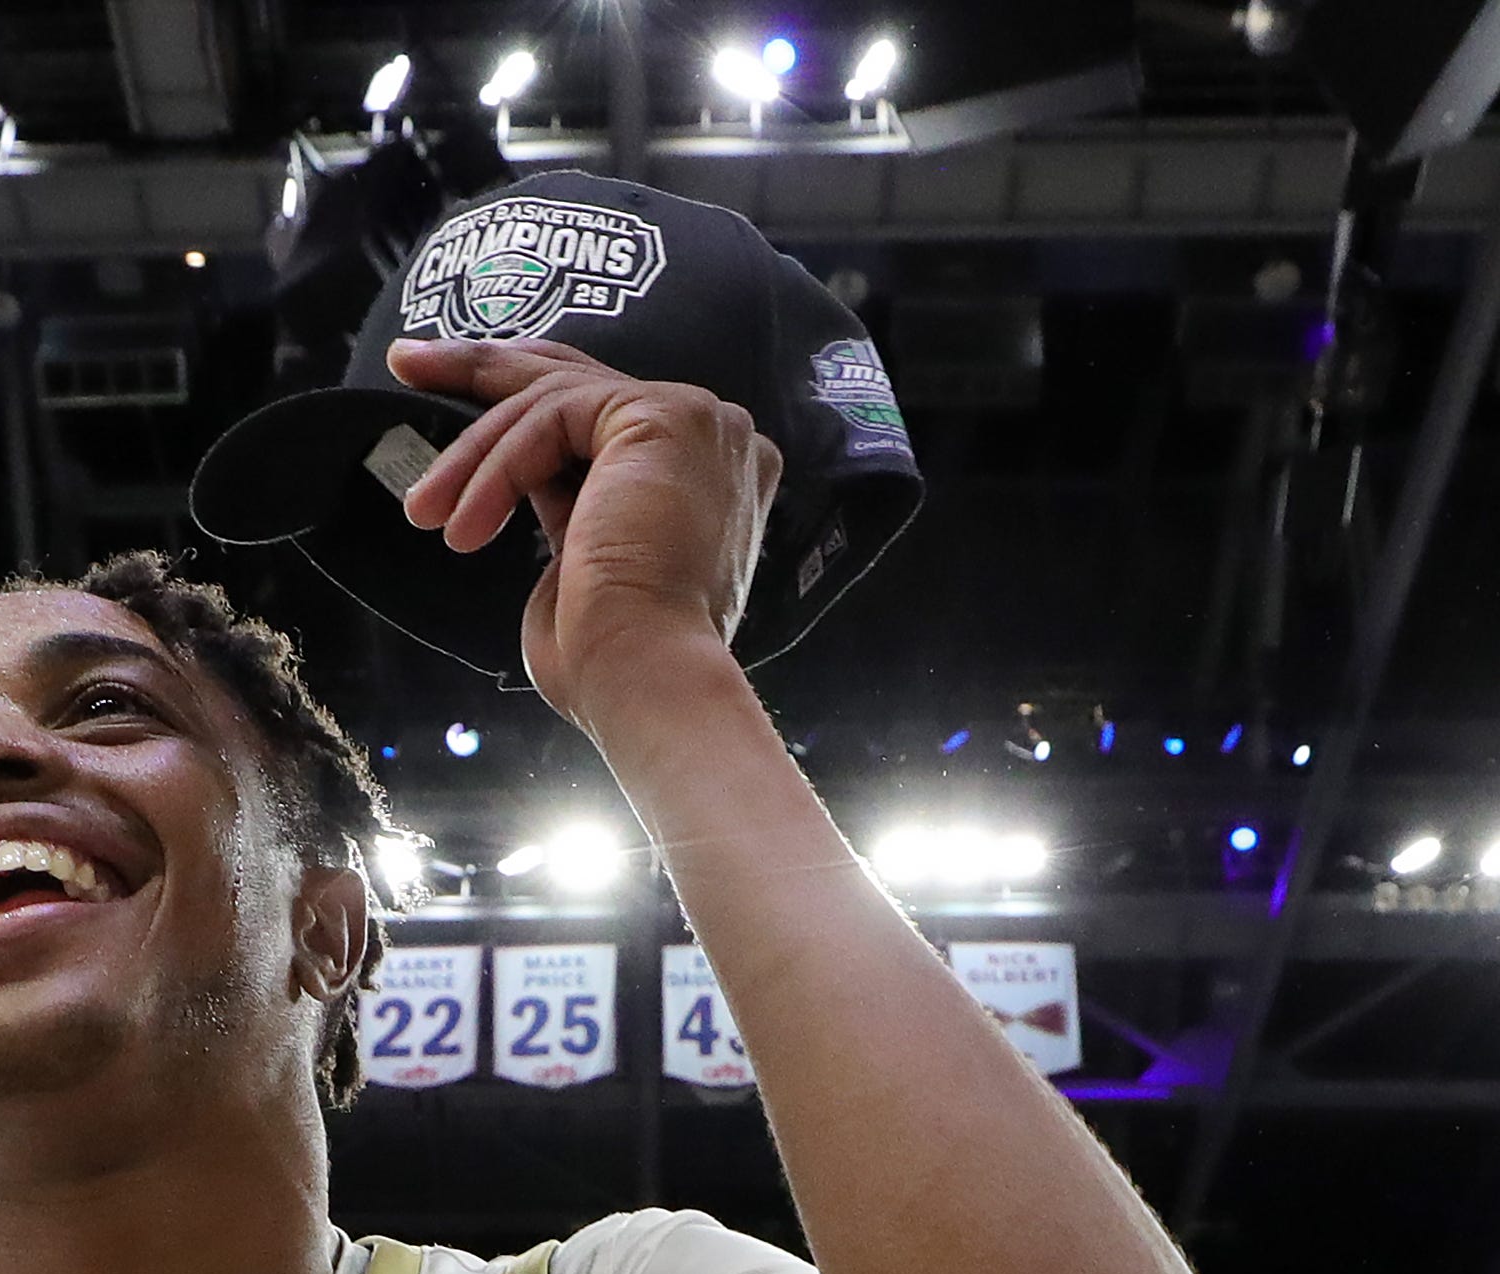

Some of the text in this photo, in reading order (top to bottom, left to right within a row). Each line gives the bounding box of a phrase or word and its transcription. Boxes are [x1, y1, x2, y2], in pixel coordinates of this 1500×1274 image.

[494, 205, 634, 236] BASKETBALL
[417, 221, 637, 289] CHAMPIONS
[469, 275, 541, 298] MAC
[572, 283, 609, 305] 25
[373, 997, 461, 1057] 22
[510, 995, 600, 1055] 25
[679, 995, 744, 1056] 4
